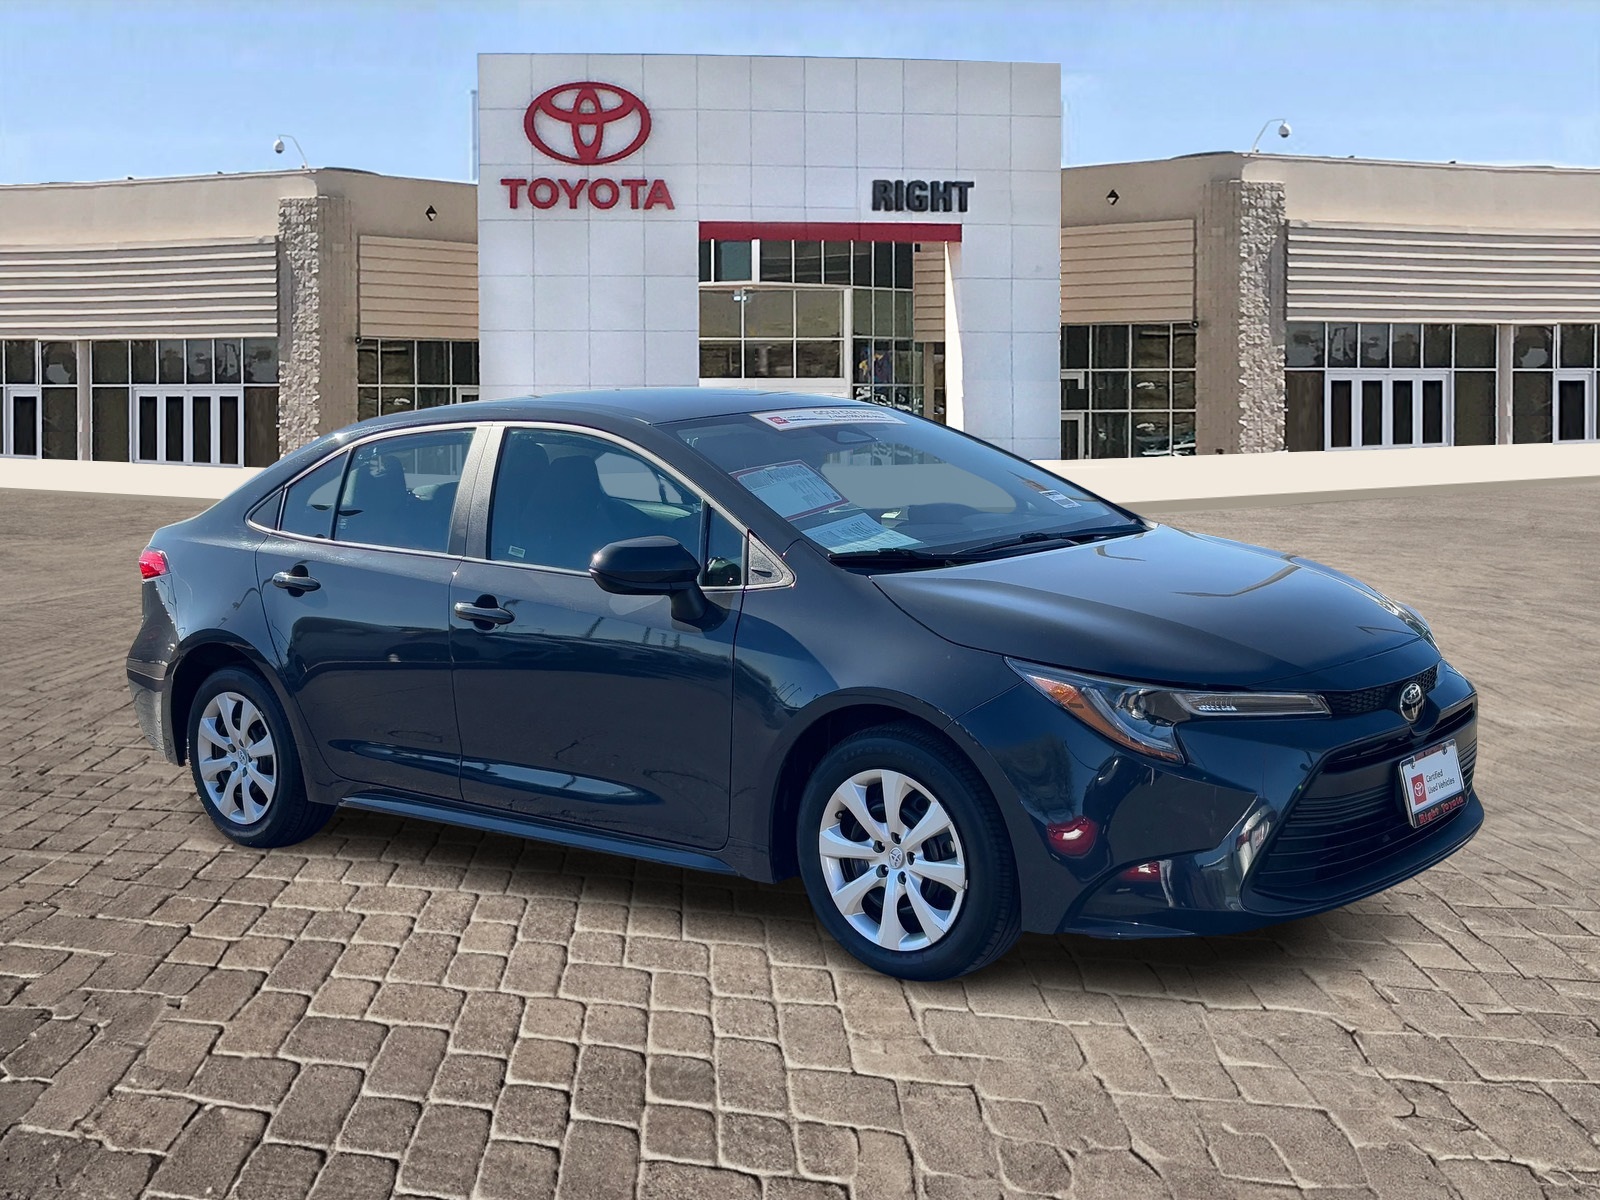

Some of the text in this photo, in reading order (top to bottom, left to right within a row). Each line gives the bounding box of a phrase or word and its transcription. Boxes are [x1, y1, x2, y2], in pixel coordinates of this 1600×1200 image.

[500, 177, 675, 210] TOYOTA
[871, 179, 975, 213] RIGHT
[1425, 769, 1444, 782] Certified
[1427, 777, 1455, 794] Used Vehicles
[1418, 796, 1464, 824] Right Toyota
